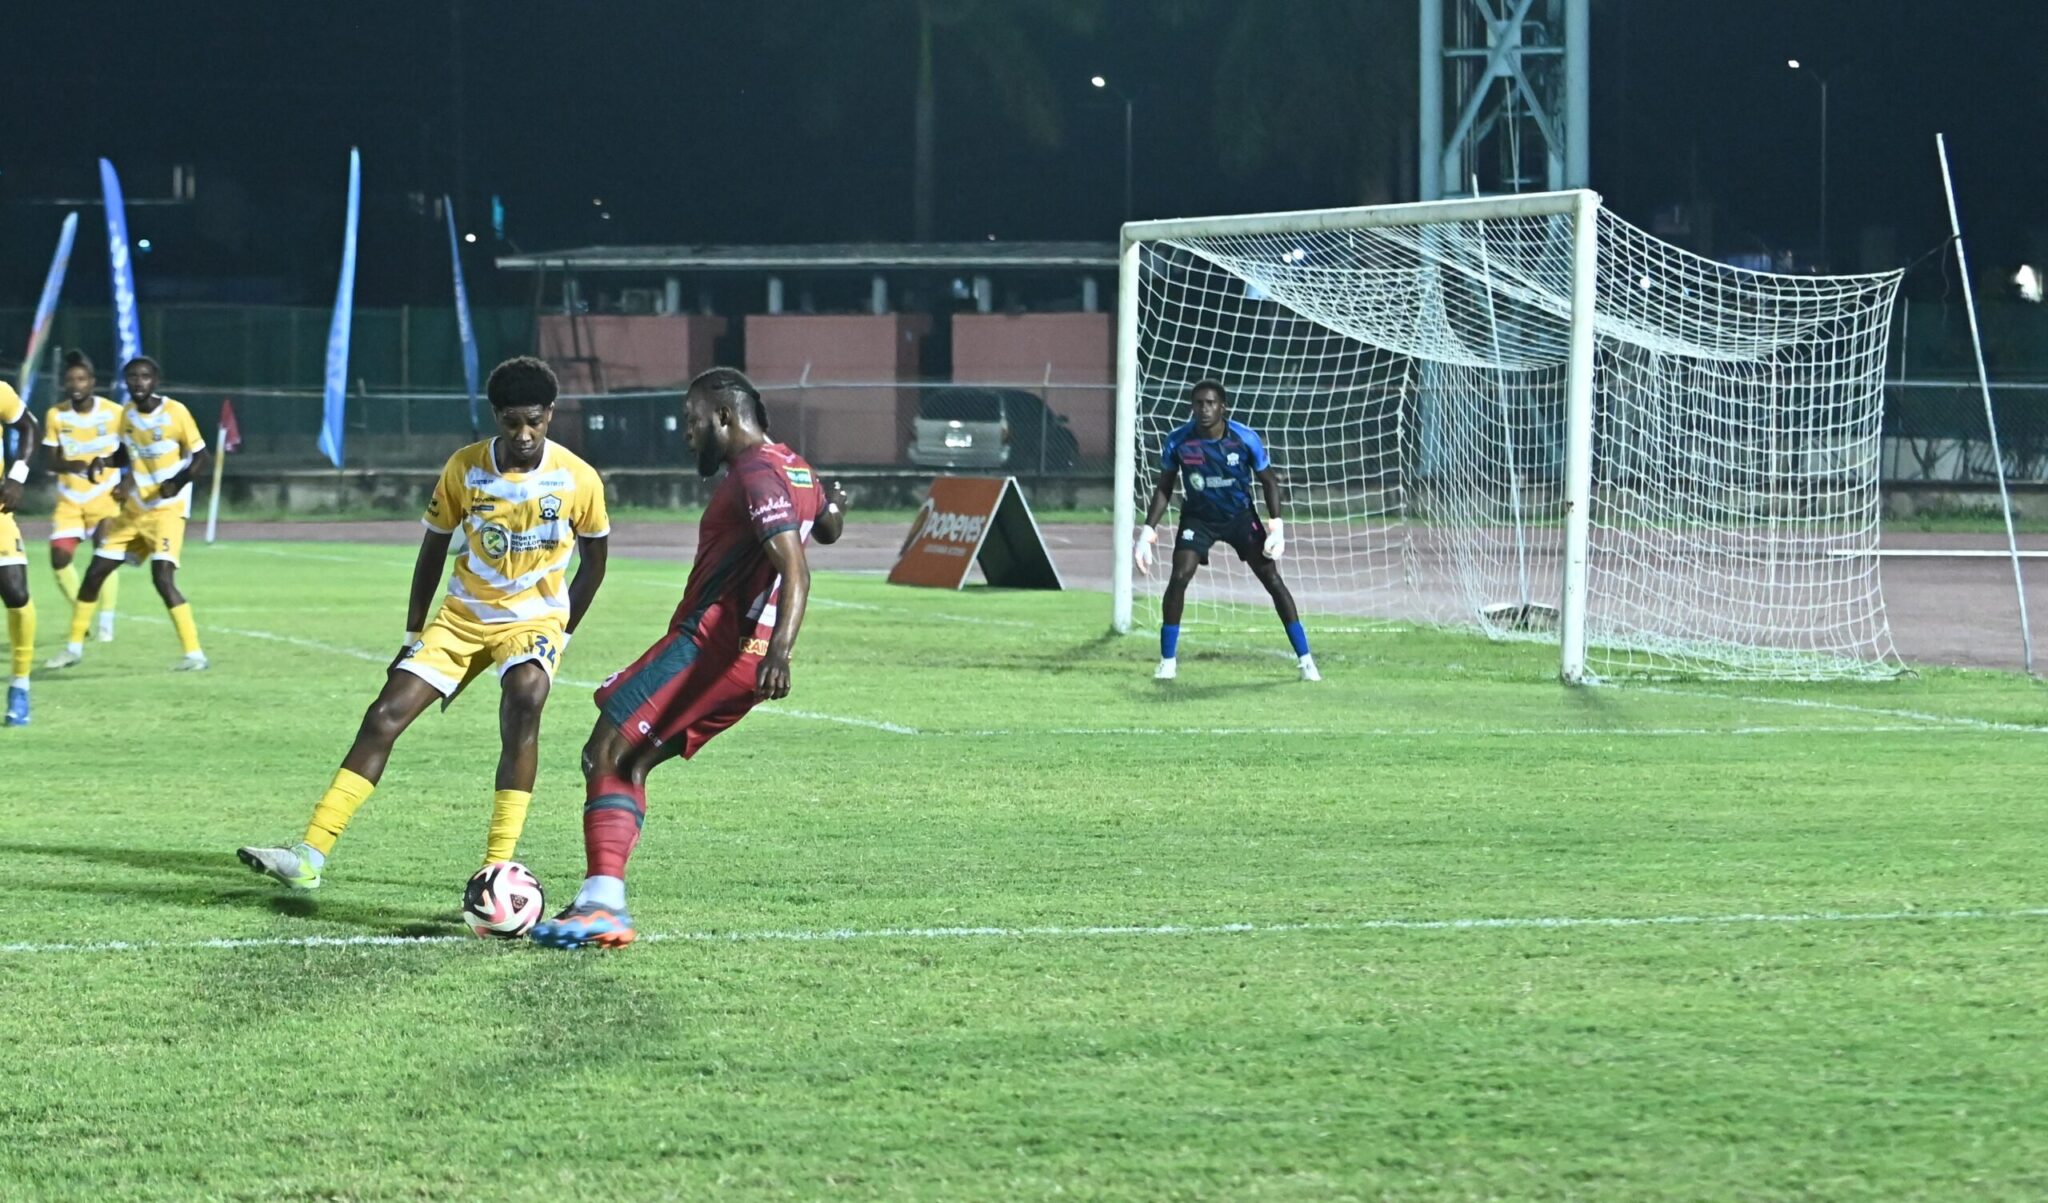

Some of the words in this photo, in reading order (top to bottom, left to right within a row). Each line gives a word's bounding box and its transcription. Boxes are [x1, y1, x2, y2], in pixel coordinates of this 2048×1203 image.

[922, 511, 986, 543] POPEYES
[162, 538, 169, 552] 3
[511, 539, 559, 547] DEVELOPMENT
[511, 544, 554, 552] FOUNDATION
